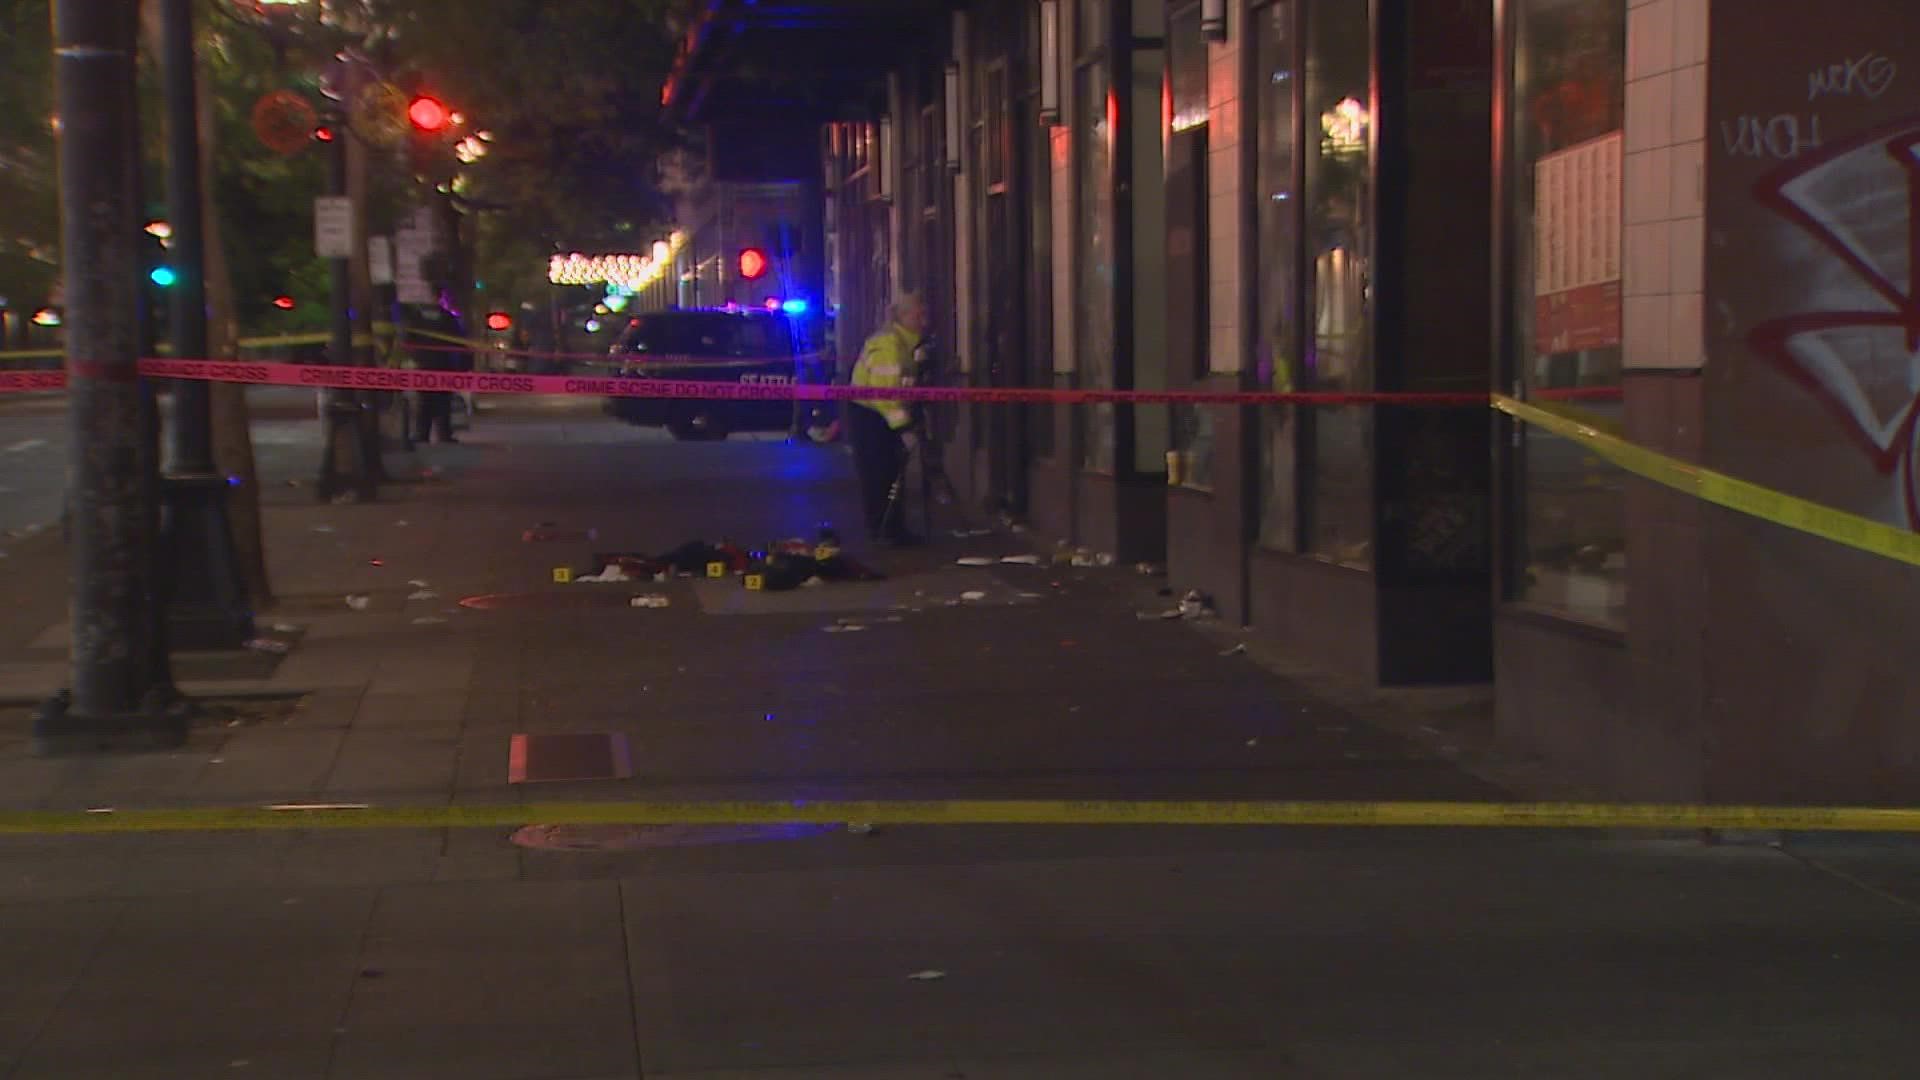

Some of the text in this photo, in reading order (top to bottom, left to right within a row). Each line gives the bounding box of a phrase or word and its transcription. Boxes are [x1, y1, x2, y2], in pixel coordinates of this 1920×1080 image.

[210, 364, 269, 381] CROSS
[299, 368, 534, 391] CRIME SCENE DO NOT CROSS
[564, 379, 794, 399] CRIME SCENE DO NOT CROSS
